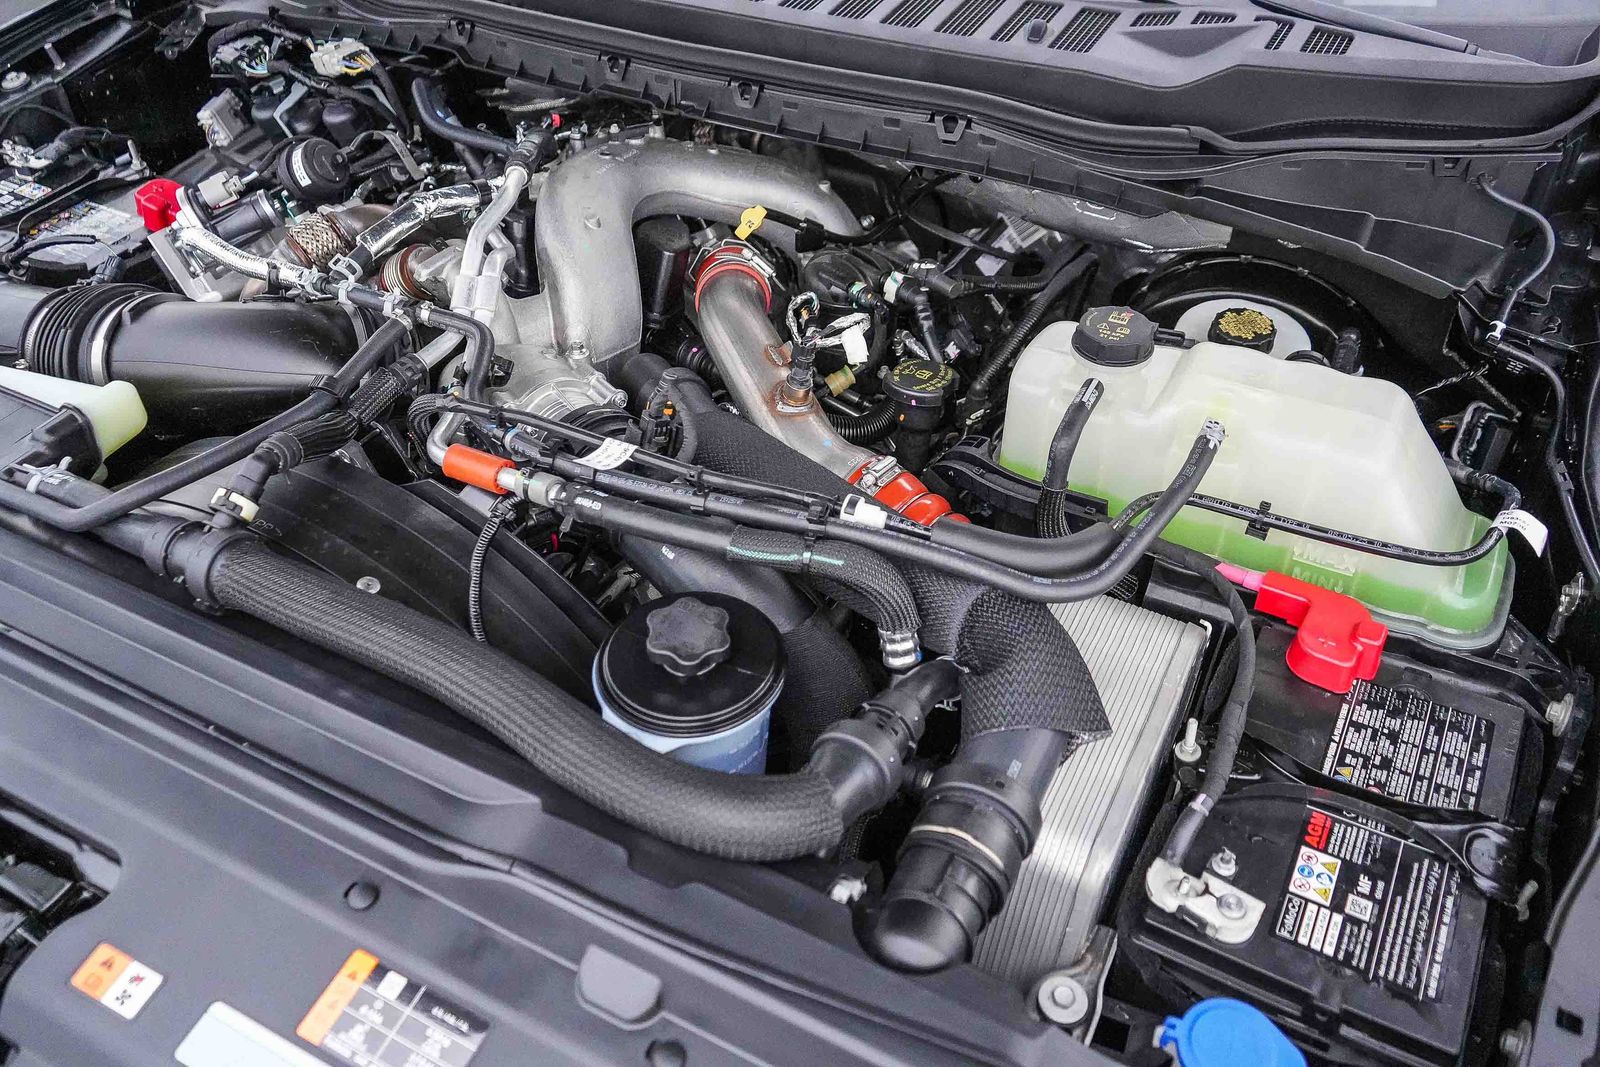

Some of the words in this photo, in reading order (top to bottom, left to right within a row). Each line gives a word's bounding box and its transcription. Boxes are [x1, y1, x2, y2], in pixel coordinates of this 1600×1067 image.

[1304, 811, 1326, 848] AGM
[1357, 873, 1372, 895] MF
[1279, 898, 1300, 935] FoMoCo
